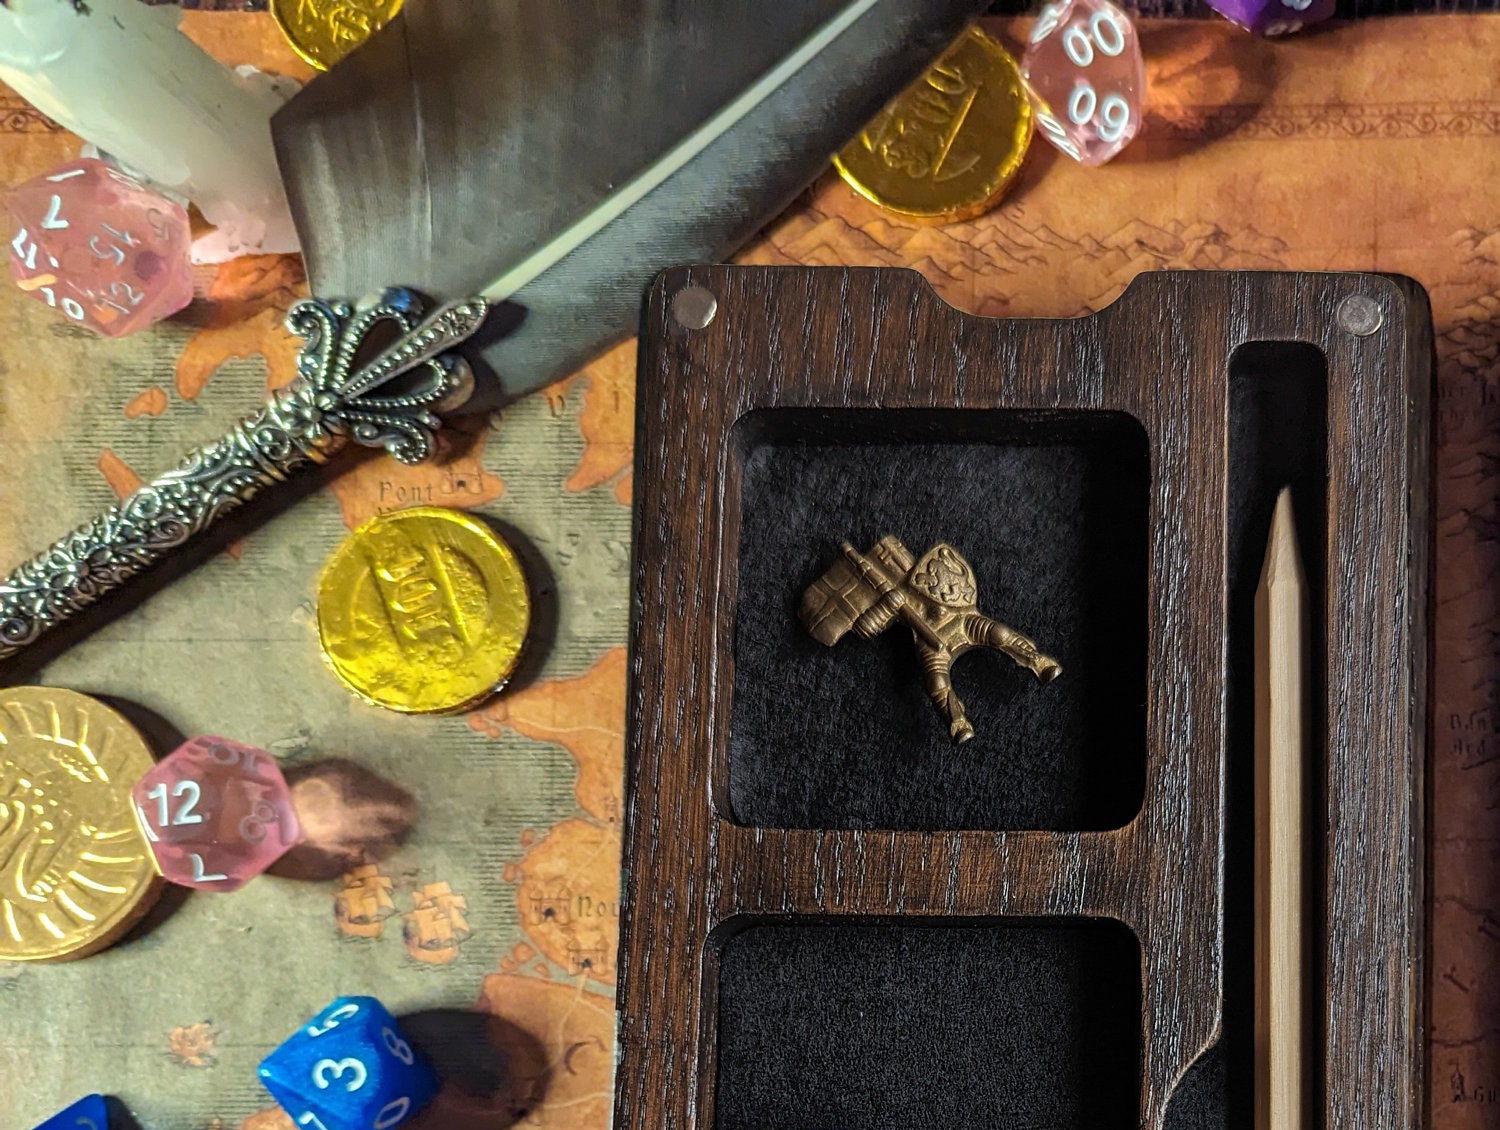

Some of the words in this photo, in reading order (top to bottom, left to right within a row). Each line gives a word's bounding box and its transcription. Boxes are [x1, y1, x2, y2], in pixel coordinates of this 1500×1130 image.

[1063, 11, 1126, 67] 00
[148, 779, 203, 828] 12
[306, 1003, 360, 1038] 5
[311, 1057, 368, 1092] 3
